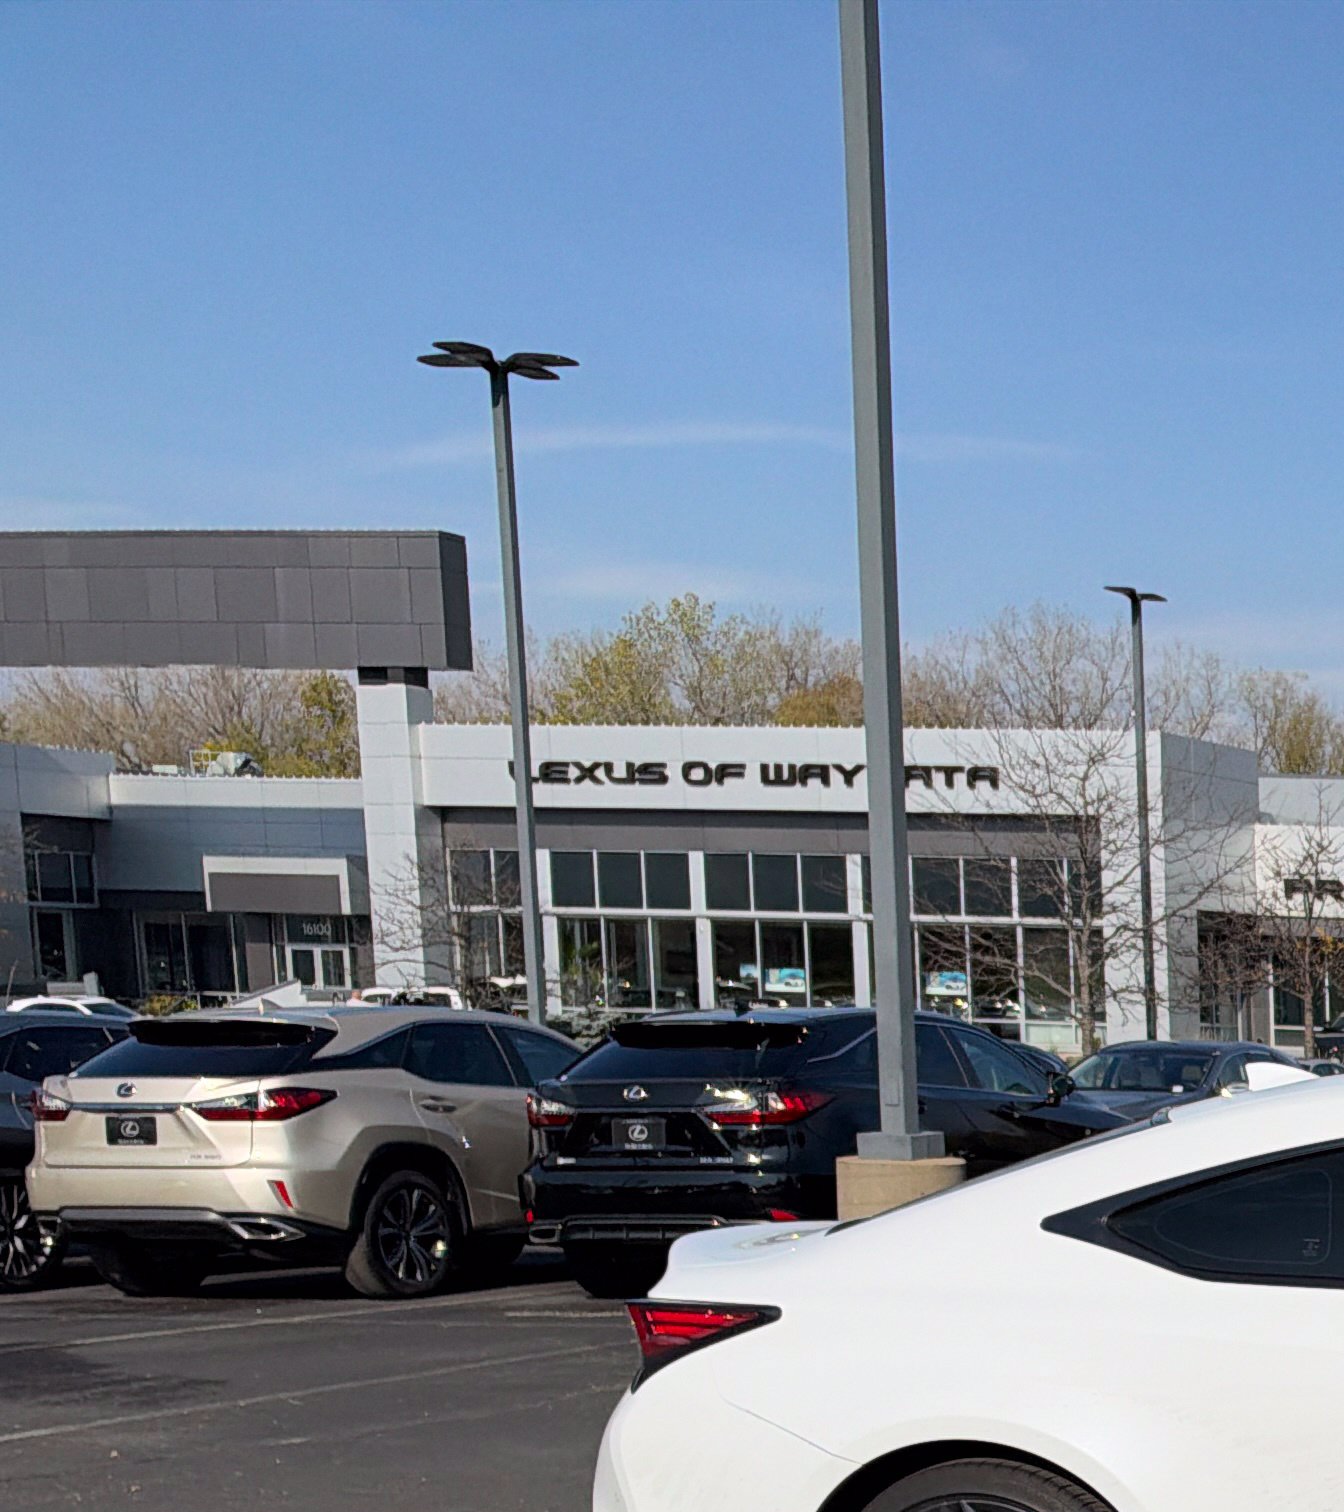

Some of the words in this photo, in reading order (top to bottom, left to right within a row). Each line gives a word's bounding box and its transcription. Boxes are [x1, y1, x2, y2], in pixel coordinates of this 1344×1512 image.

[682, 761, 746, 787] OF
[760, 763, 999, 790] WAYATA
[302, 922, 331, 936] 16100
